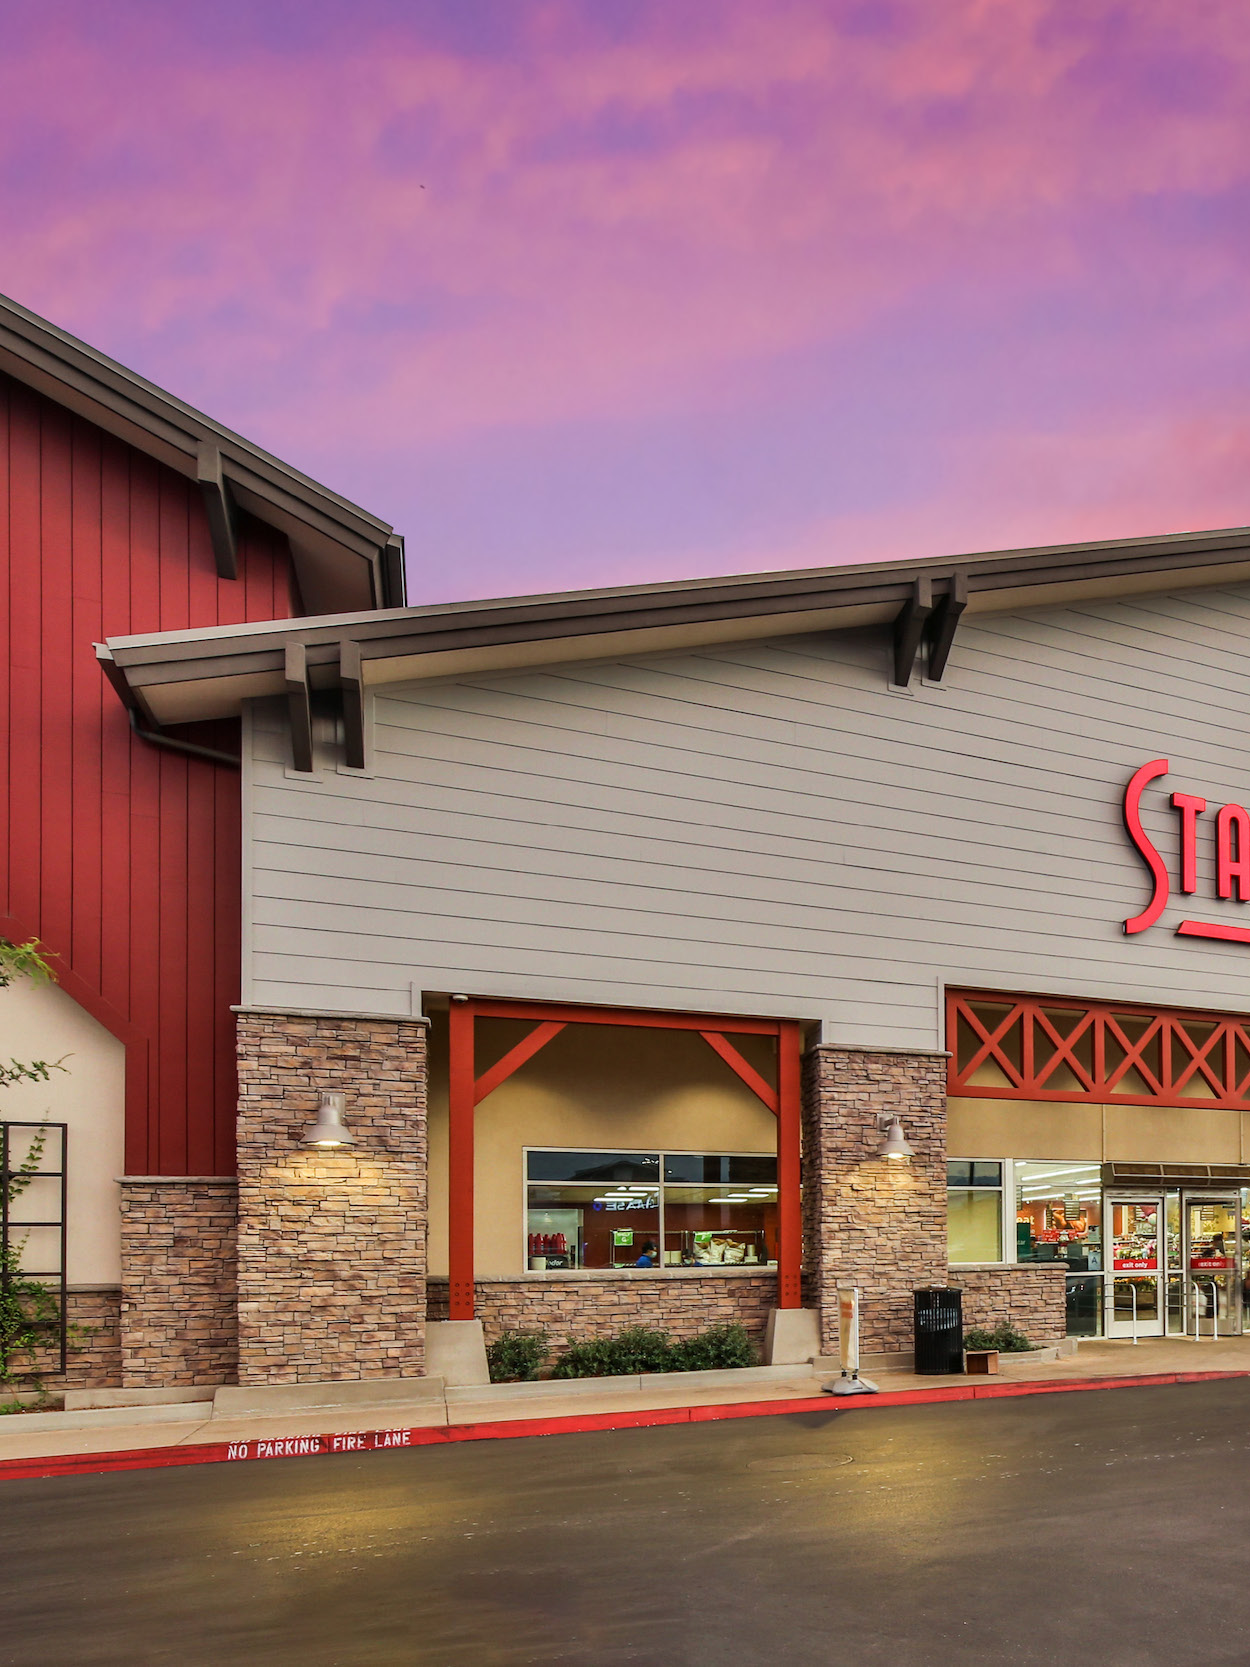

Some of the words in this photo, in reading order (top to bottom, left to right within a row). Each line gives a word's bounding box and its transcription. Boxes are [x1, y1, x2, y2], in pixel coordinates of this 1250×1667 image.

[1091, 1257, 1098, 1265] A
[1134, 1261, 1148, 1269] only
[227, 1444, 248, 1460] NO
[257, 1438, 320, 1458] PARKING
[333, 1436, 366, 1450] FIRE
[374, 1431, 412, 1448] LANE
